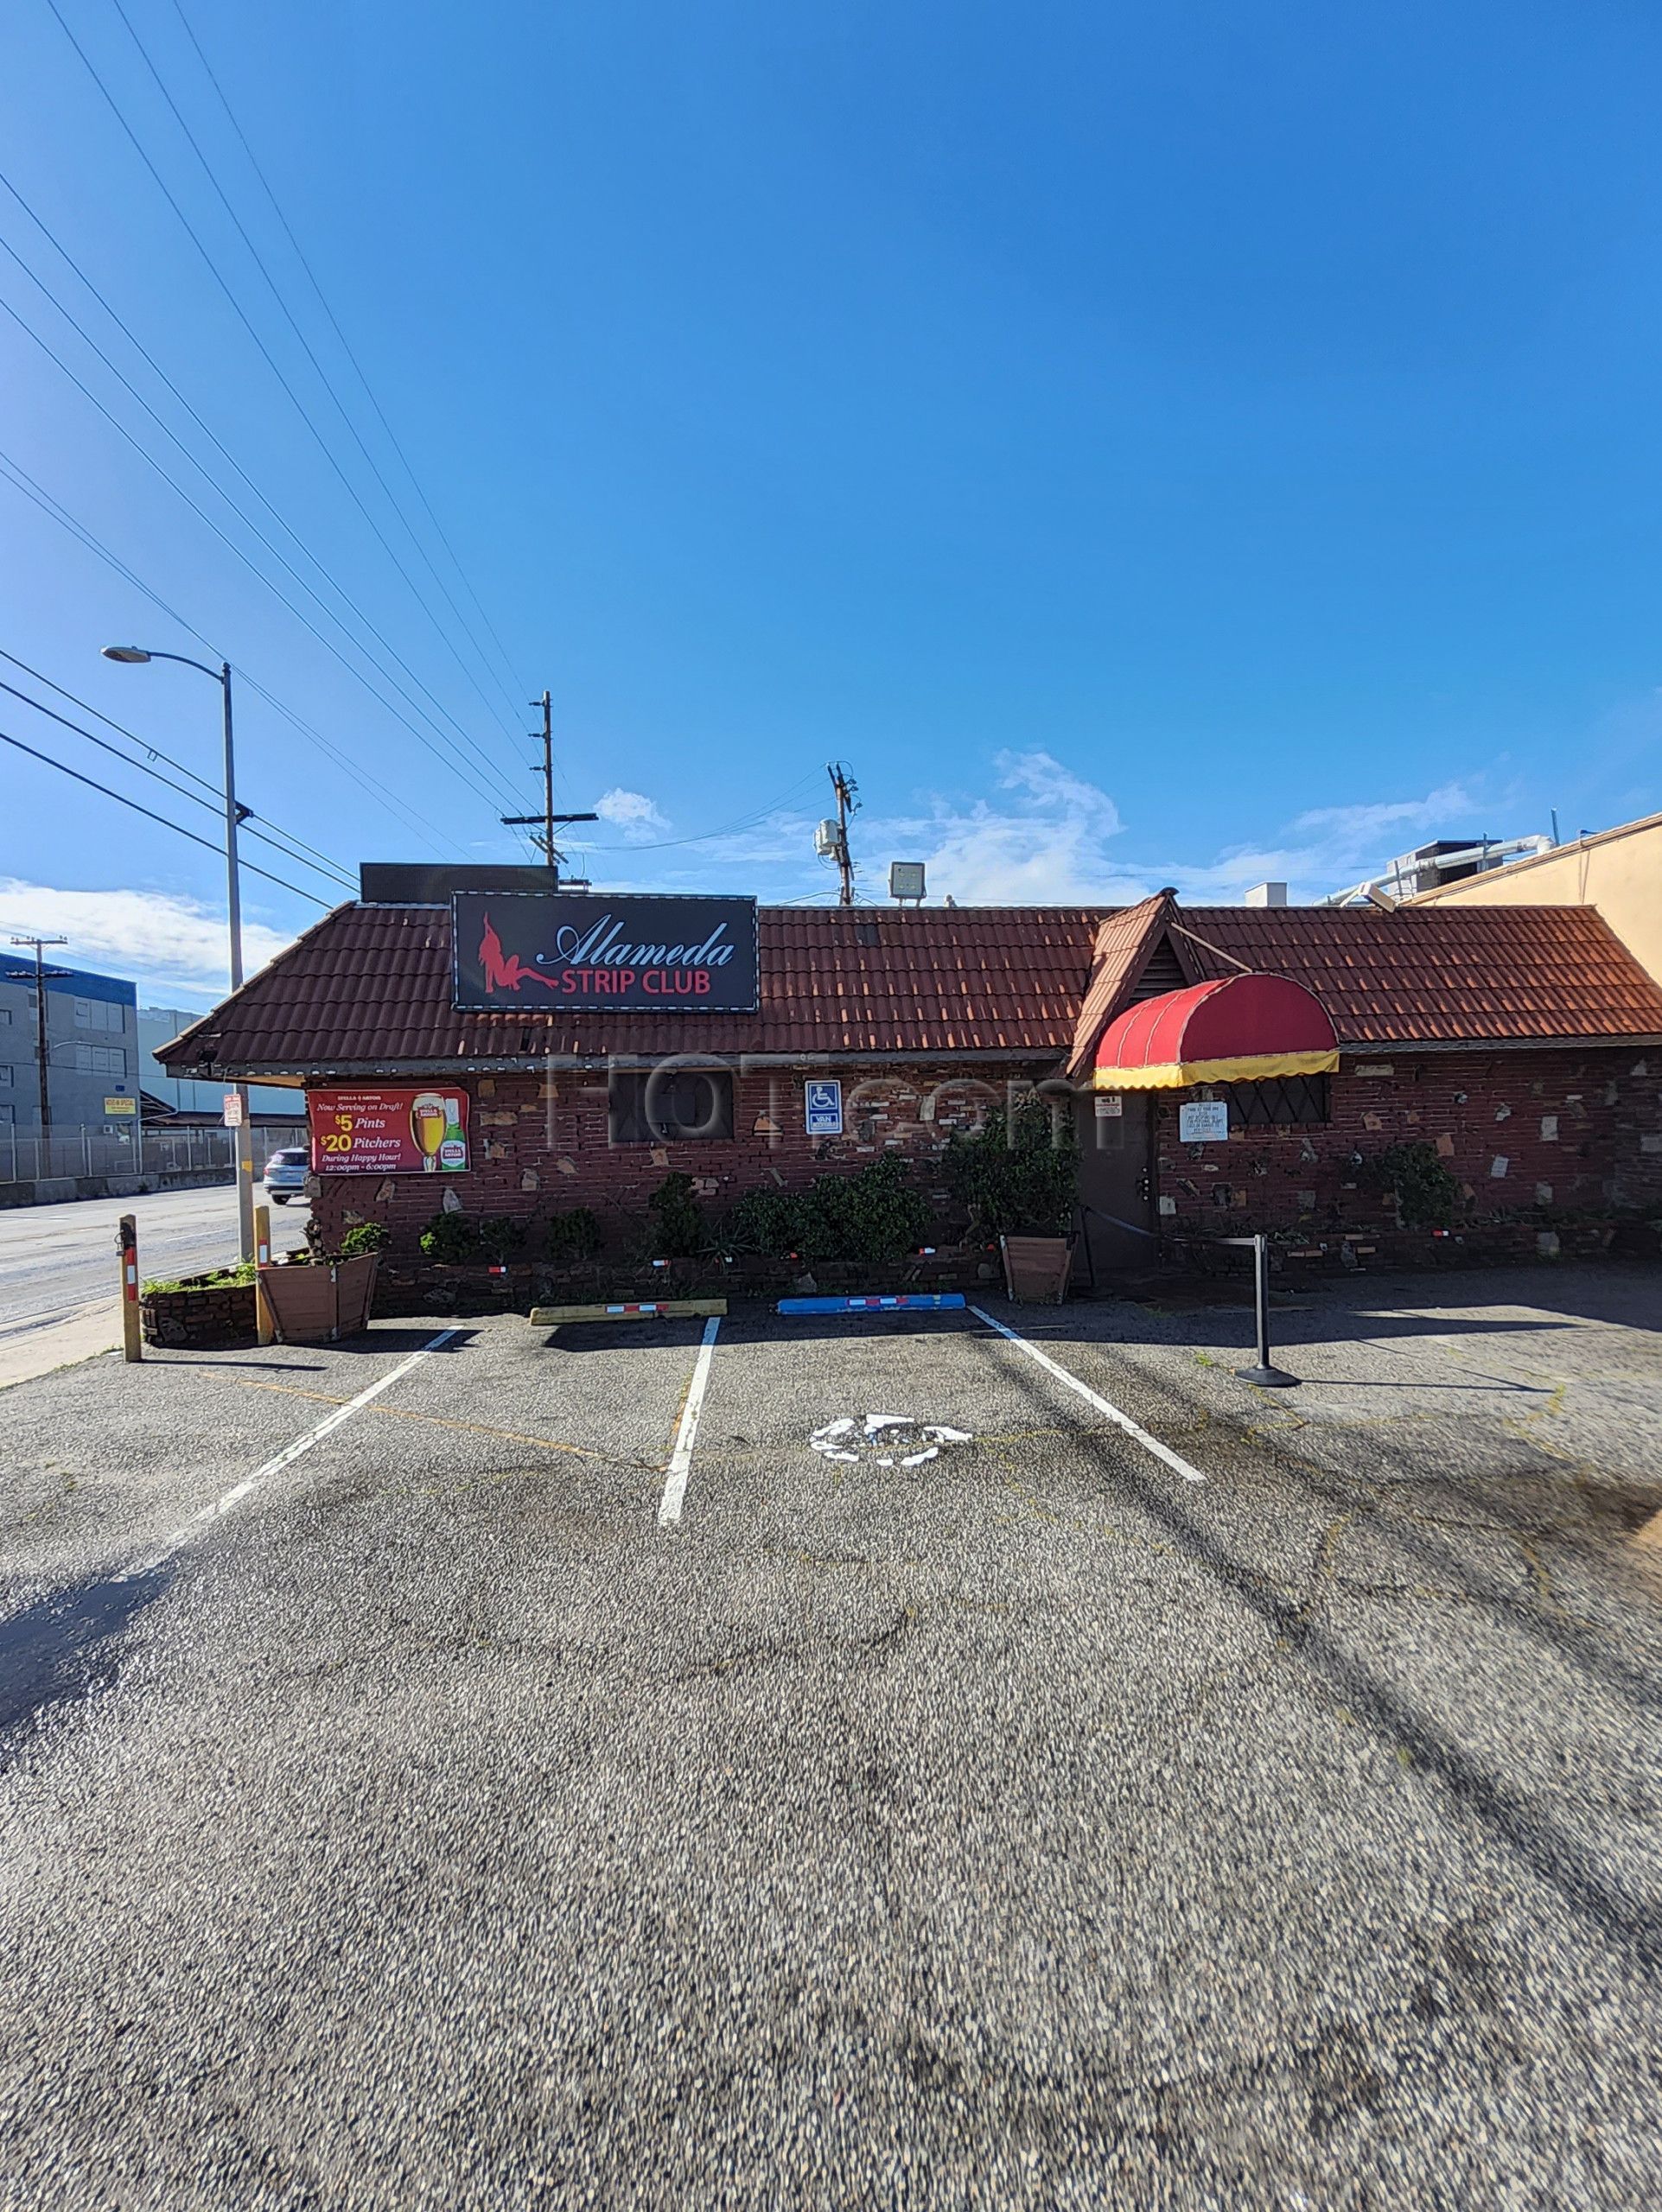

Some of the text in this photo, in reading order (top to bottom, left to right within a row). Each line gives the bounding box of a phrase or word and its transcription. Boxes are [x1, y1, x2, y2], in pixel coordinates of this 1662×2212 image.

[536, 913, 734, 966] Alameda
[562, 969, 710, 994] STRIP CLUB
[336, 1103, 366, 1112] Serving
[379, 1102, 404, 1111] Draft!
[334, 1114, 385, 1131] $5 Pints
[321, 1134, 401, 1152] $20 Pitchers
[322, 1153, 401, 1164] During Happy Hour!
[325, 1164, 360, 1173] 12:00pm
[366, 1162, 396, 1171] 6:00pm
